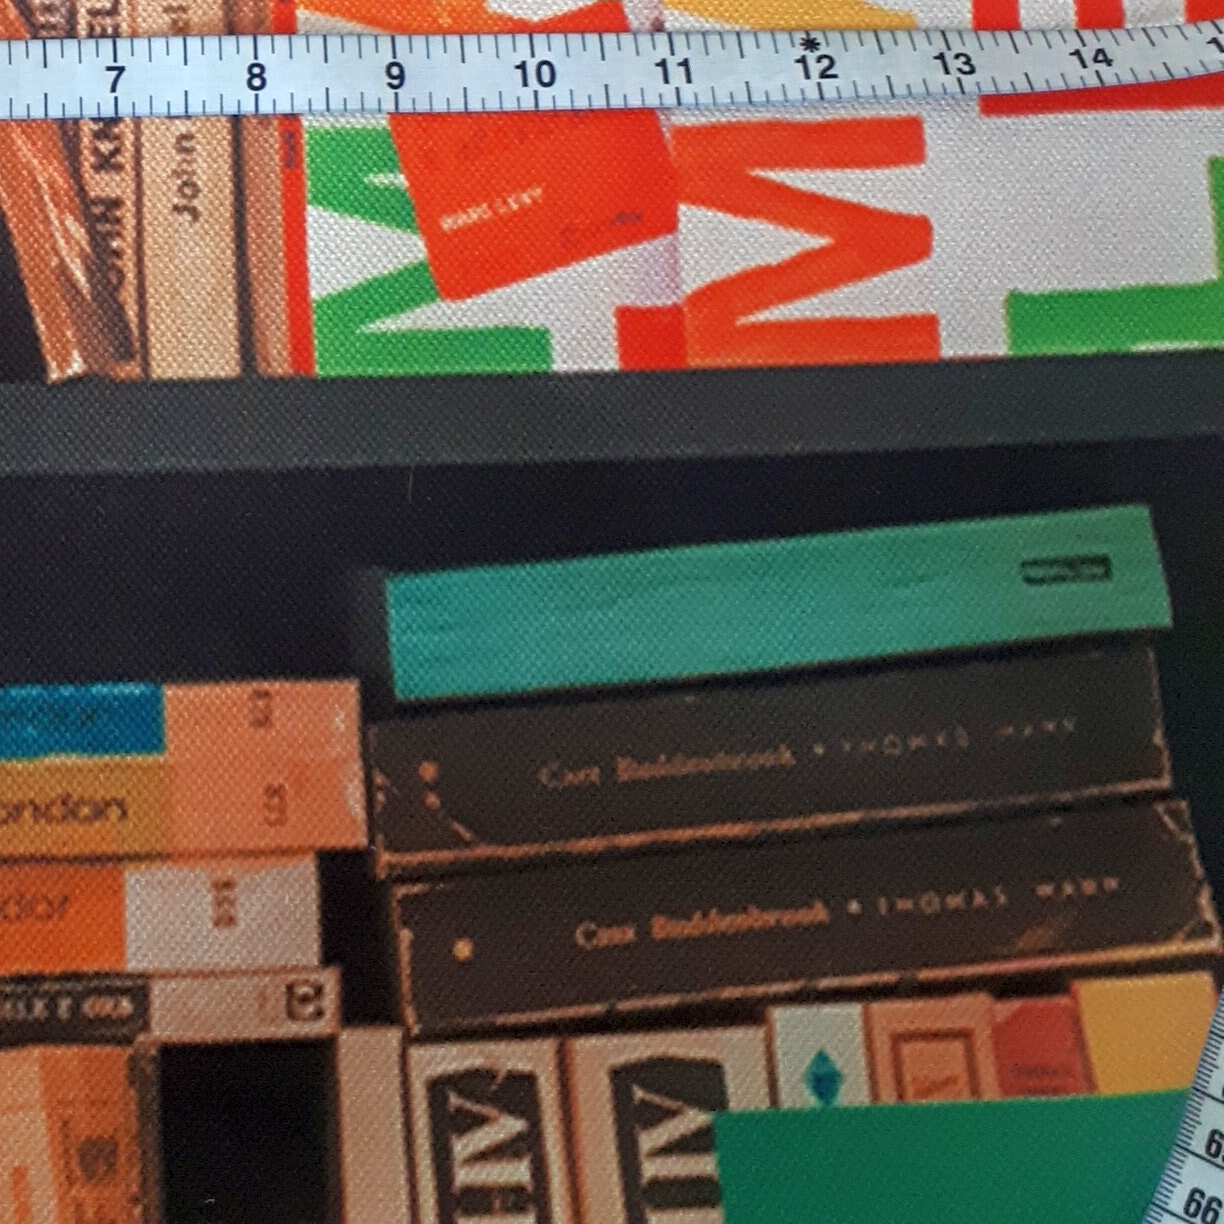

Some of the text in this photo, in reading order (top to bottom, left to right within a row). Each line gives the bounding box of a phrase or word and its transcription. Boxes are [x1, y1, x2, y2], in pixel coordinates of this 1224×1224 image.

[104, 66, 126, 95] 7
[246, 62, 268, 92] 8
[384, 61, 407, 90] 9
[513, 58, 557, 89] 10
[654, 56, 694, 85] 11
[794, 54, 839, 81] 12
[932, 50, 977, 77] 13
[1068, 46, 1115, 71] 14
[169, 132, 201, 223] John
